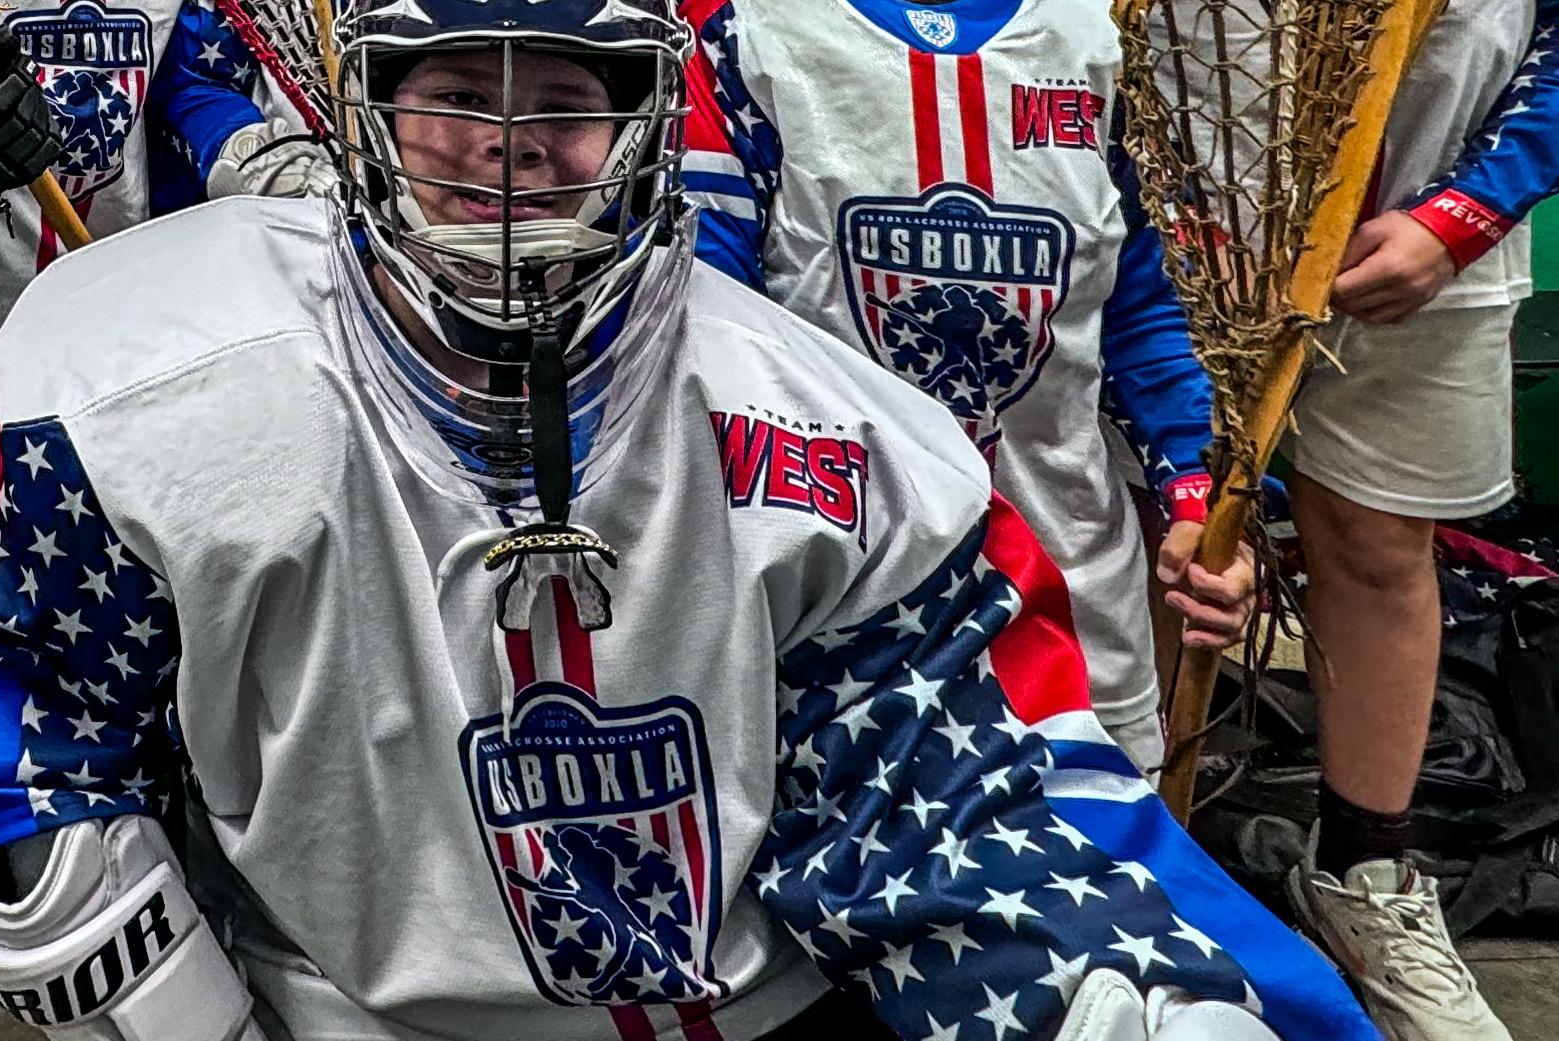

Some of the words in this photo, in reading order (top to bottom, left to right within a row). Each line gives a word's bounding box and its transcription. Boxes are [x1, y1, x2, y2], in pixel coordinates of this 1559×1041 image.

[19, 31, 144, 62] USBOXLA
[859, 225, 1051, 278] USBOXLA
[763, 409, 823, 433] TEAM
[709, 411, 870, 555] WEST
[577, 723, 676, 747] ASSOCIATION
[486, 740, 688, 816] USBOXLA
